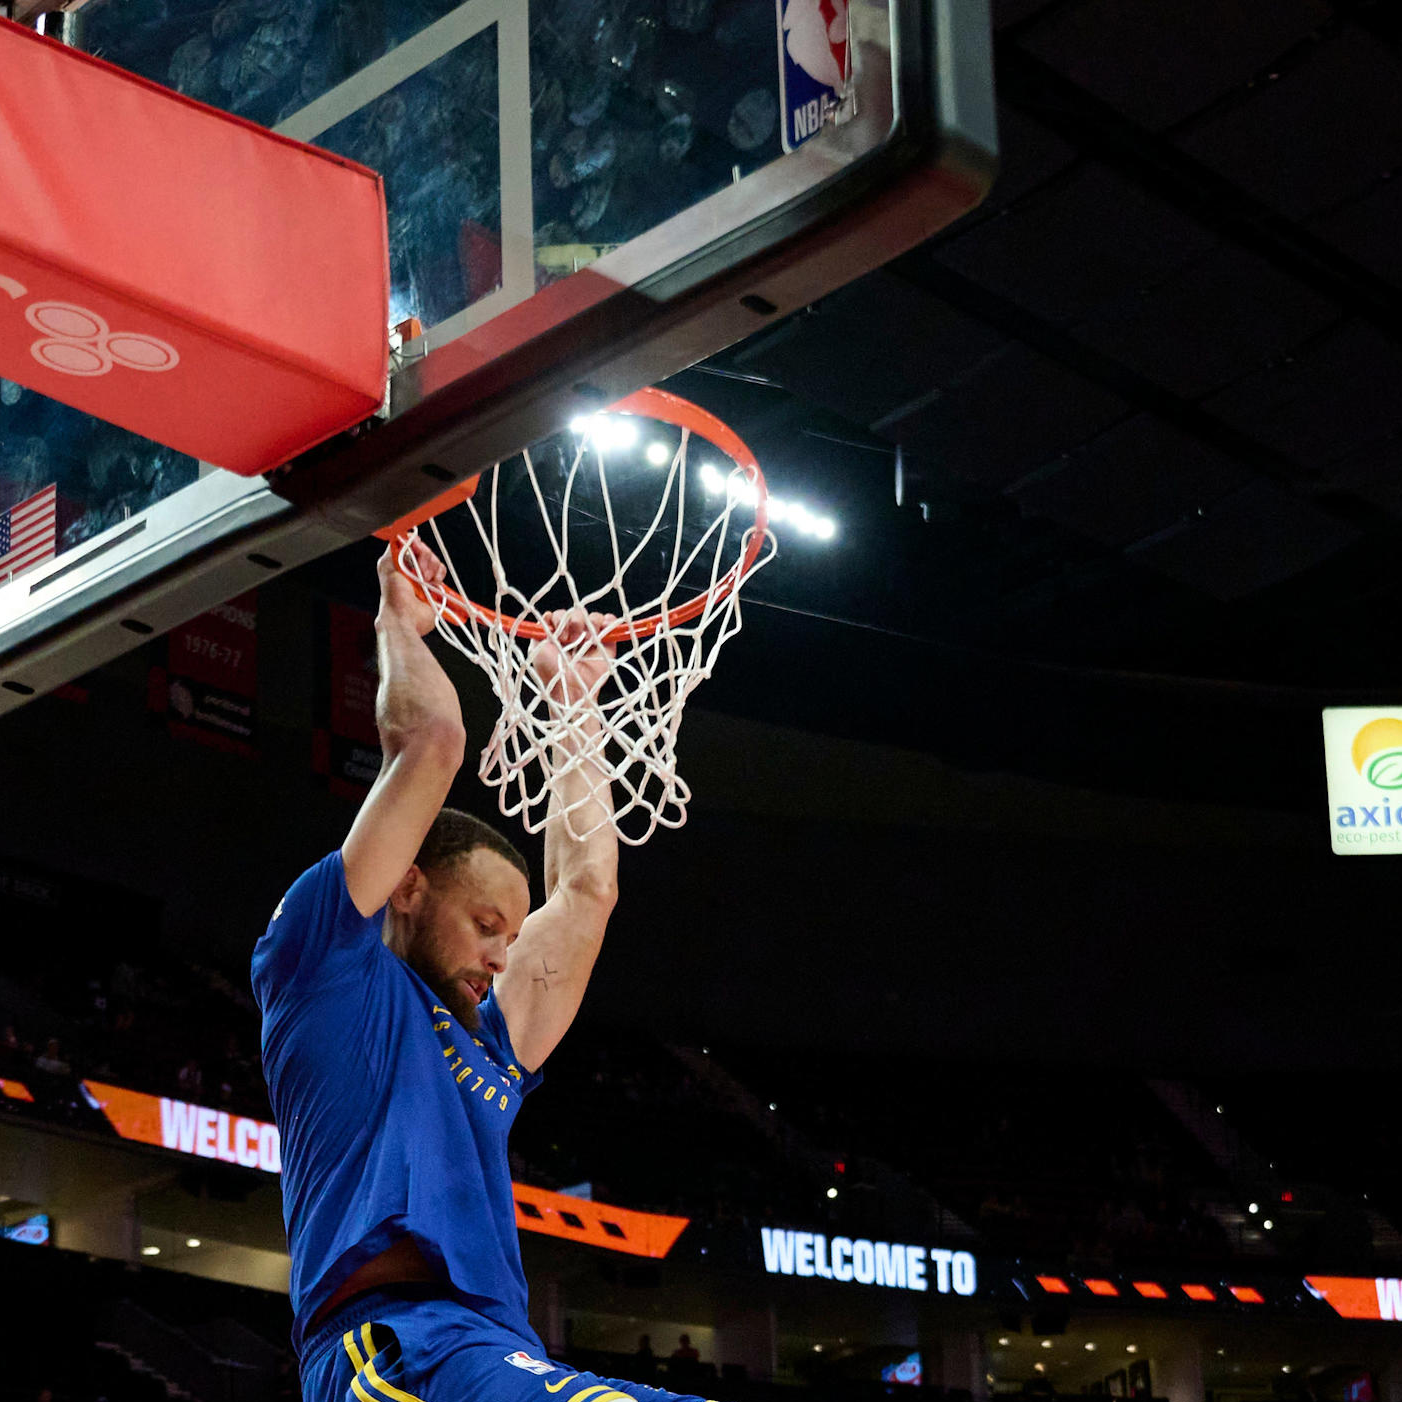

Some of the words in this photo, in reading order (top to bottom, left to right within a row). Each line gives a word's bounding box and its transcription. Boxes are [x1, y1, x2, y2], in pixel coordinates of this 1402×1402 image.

[1336, 830, 1401, 844] eco-pest
[760, 1227, 928, 1293] WELCOME
[930, 1248, 978, 1297] TO
